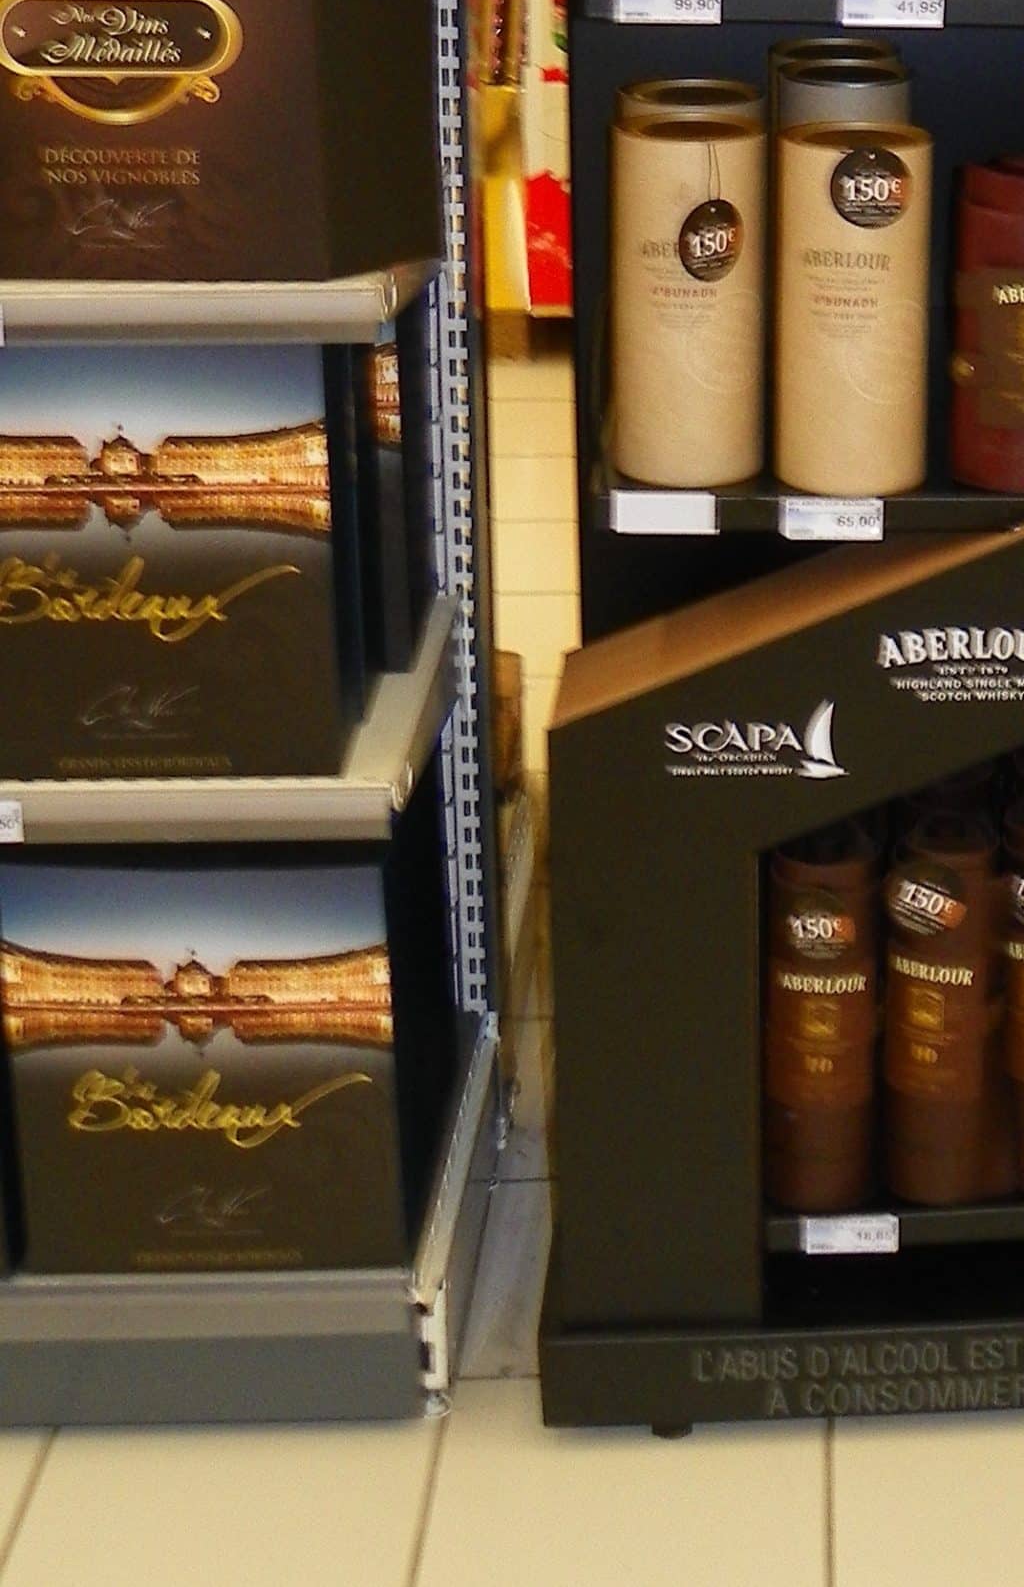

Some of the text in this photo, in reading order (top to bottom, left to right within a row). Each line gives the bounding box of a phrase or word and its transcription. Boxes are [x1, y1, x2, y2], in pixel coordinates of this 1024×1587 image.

[51, 4, 170, 36] Nos Vins
[40, 35, 182, 64] Médaillés
[44, 146, 201, 164] DÉCOUVERTE DE
[47, 167, 201, 185] NOS VIGNOBLES
[803, 249, 892, 272] ABERLOUR
[896, 678, 962, 690] HIGHLAND
[965, 677, 1012, 689] SINGLE
[921, 691, 973, 703] SCOTCH
[664, 720, 804, 754] SCAPA
[718, 750, 779, 763] ORCADIAN
[761, 766, 795, 776] WHISKY
[894, 955, 975, 987] ABERLOUR
[781, 973, 867, 994] ABERLOUR
[695, 1348, 799, 1383] L'ABUS
[808, 1340, 958, 1378] D'ALCOOL
[967, 1337, 1022, 1369] EST
